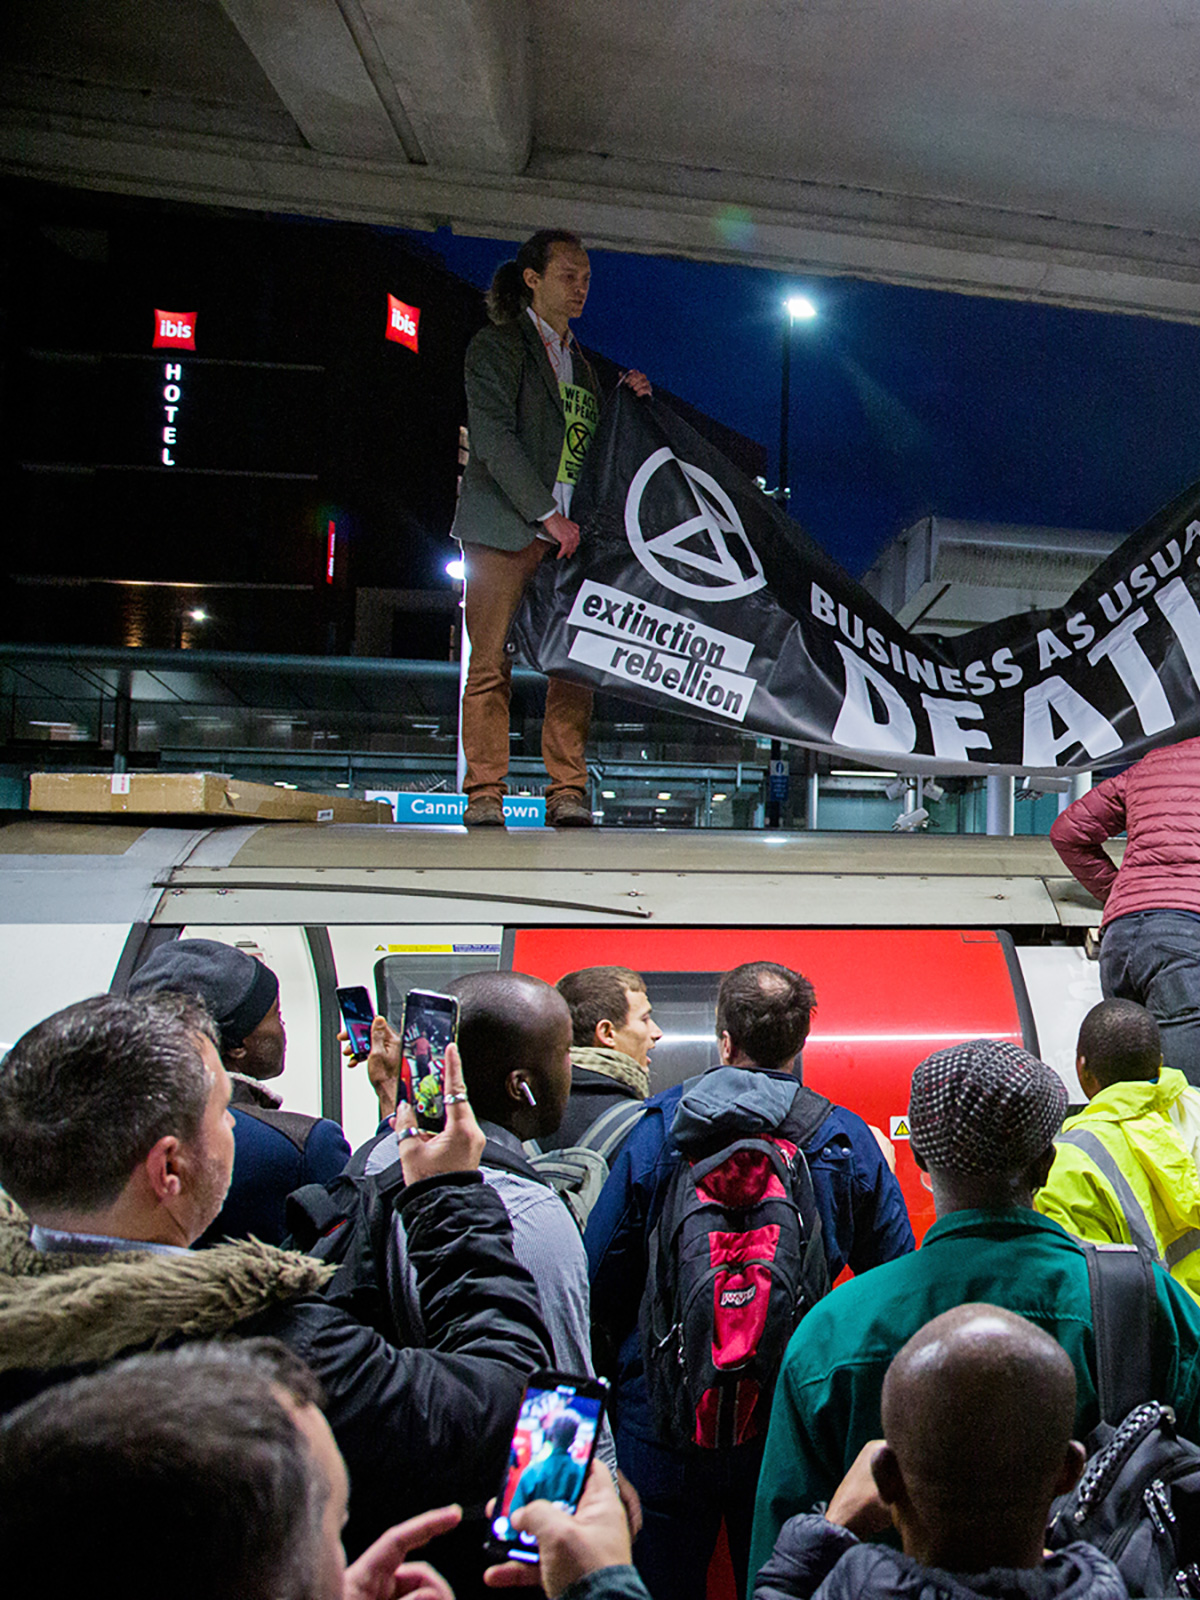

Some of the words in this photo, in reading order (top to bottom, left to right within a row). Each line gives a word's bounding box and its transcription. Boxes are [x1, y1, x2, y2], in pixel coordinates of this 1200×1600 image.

[160, 320, 191, 338] ibis
[391, 308, 416, 336] ibis
[162, 363, 182, 466] HOTEL
[564, 386, 580, 402] WE
[582, 594, 726, 666] extinction
[810, 581, 1023, 696] BUSINESS
[1037, 612, 1095, 670] AS
[610, 647, 744, 714] rebellion
[410, 799, 468, 815] Canni
[503, 805, 539, 818] own
